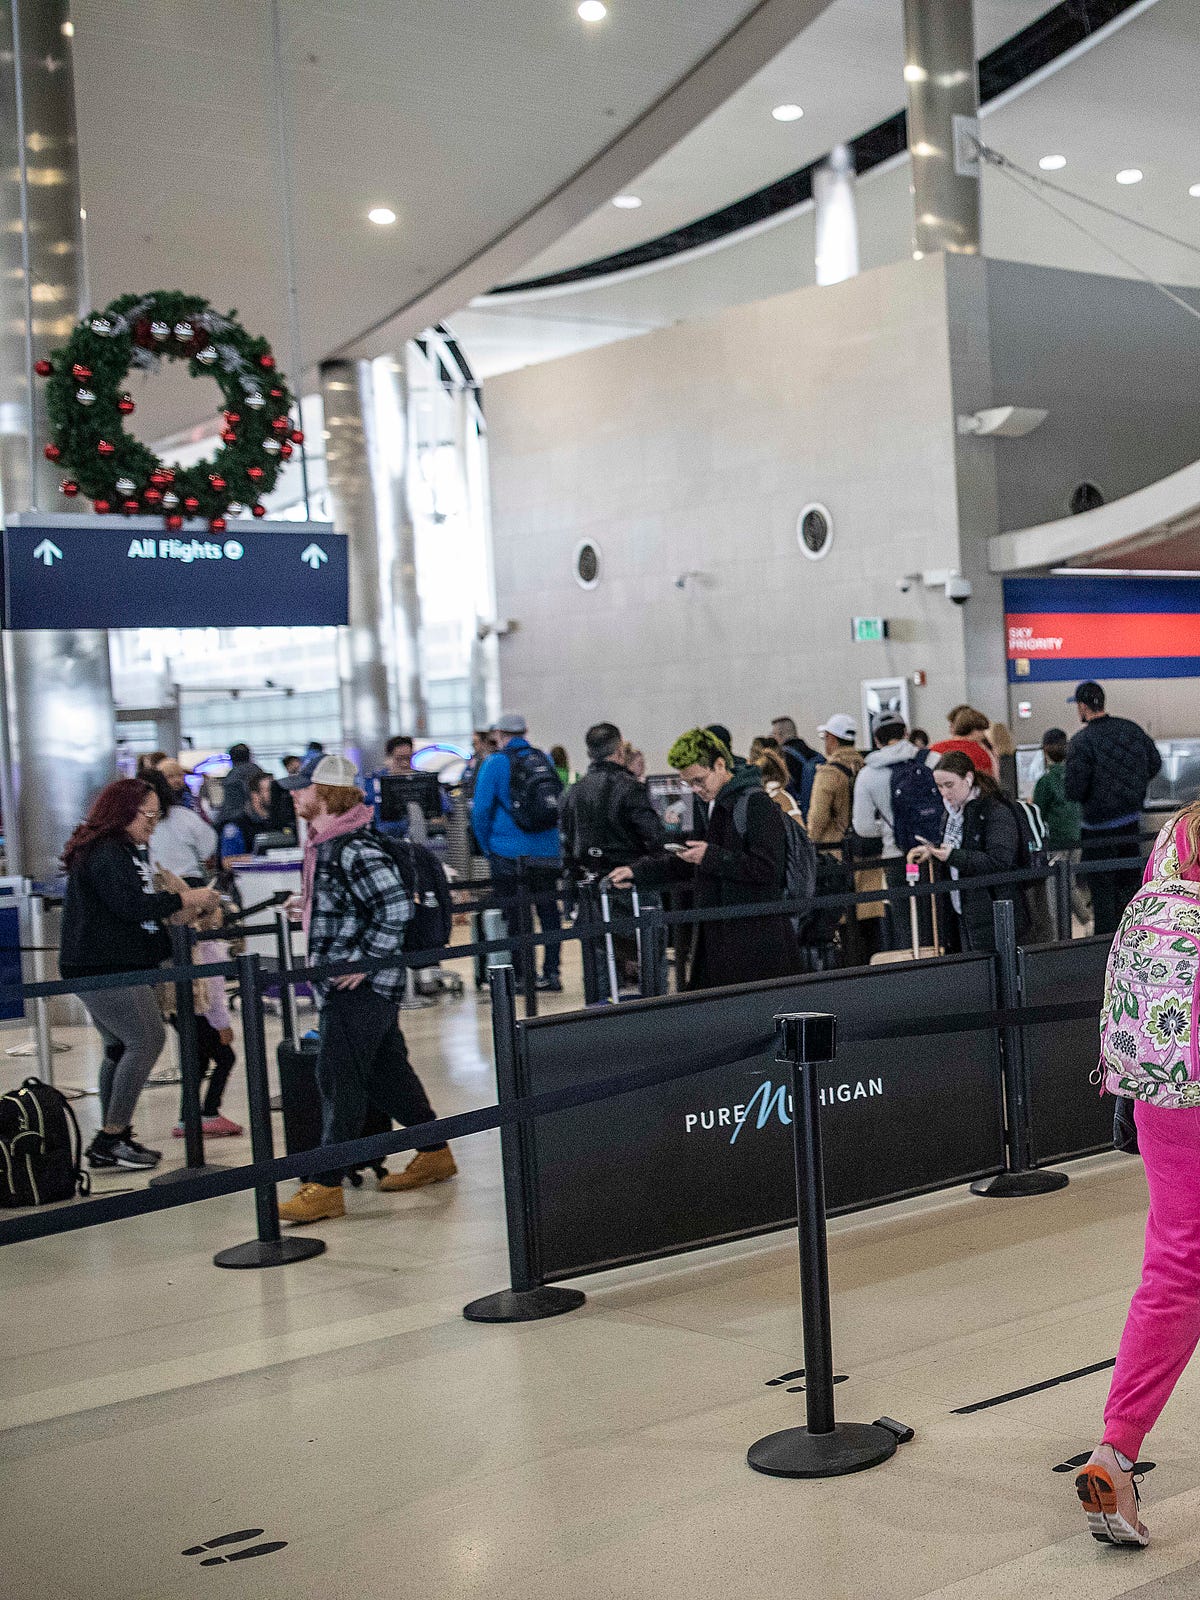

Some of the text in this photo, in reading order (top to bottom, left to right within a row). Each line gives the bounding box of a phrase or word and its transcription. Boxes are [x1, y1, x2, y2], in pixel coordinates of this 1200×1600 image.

[127, 538, 223, 563] All Flights
[685, 1078, 883, 1145] PURE MIHIGAN
